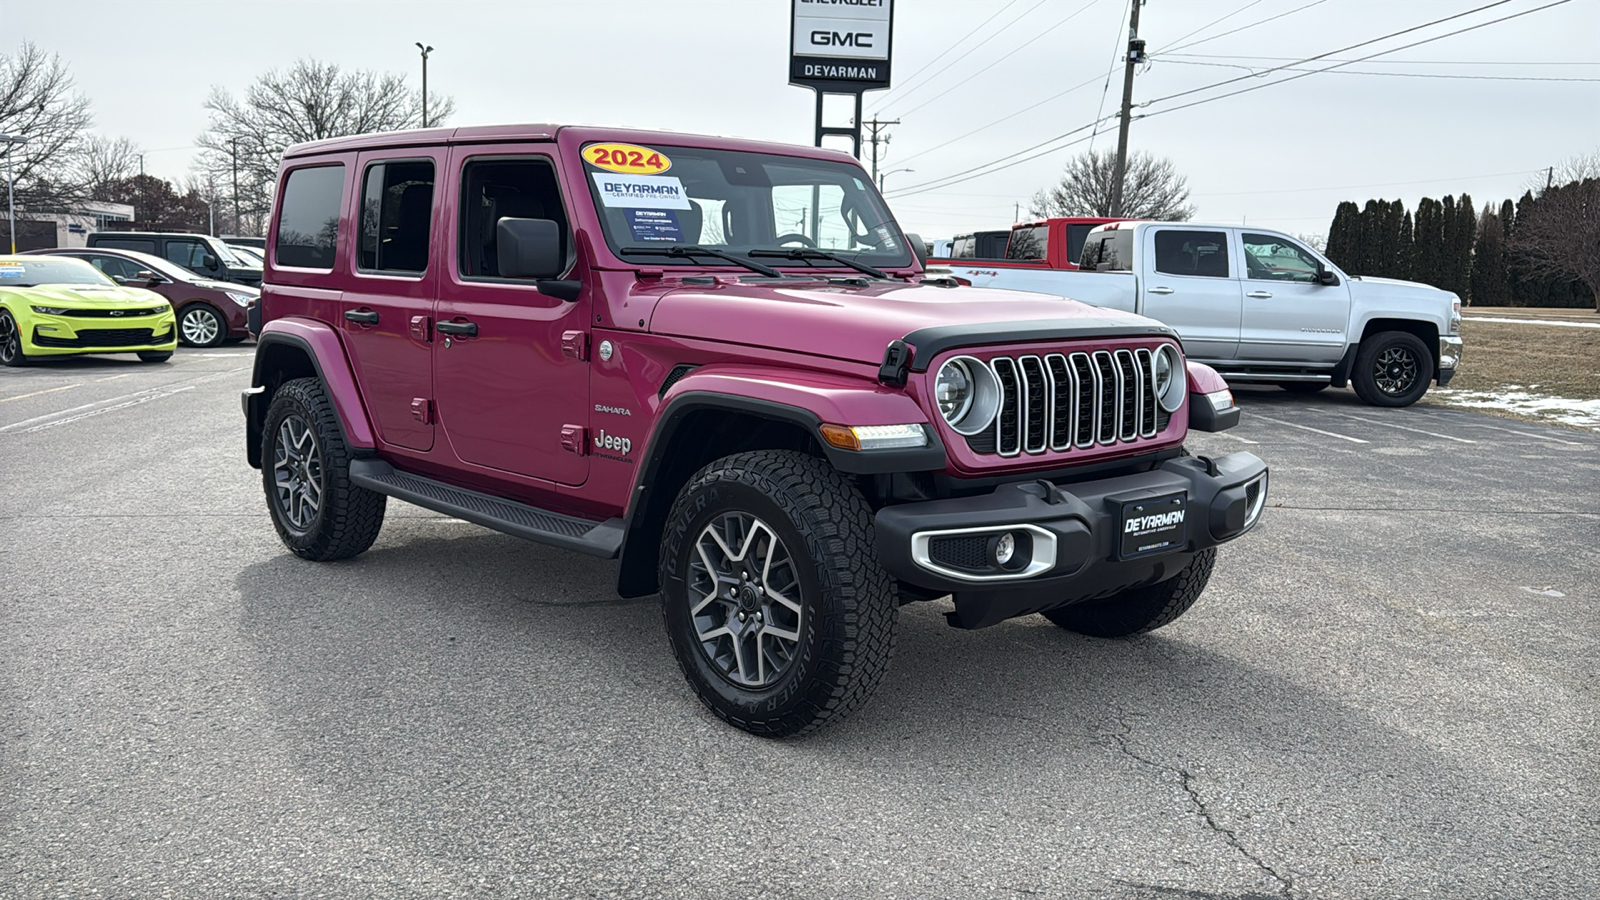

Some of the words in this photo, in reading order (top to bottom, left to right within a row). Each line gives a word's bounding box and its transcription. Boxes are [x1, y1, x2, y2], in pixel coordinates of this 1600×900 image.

[811, 31, 873, 48] GMC
[804, 64, 877, 79] DEYARMAN
[593, 148, 664, 169] 2024
[604, 182, 679, 195] DEYARMAN
[594, 404, 631, 416] SAHARA
[594, 429, 632, 456] Jeep
[667, 487, 721, 575] GENERA
[1125, 510, 1185, 533] DEYARMAN
[767, 605, 816, 712] GRABBER
